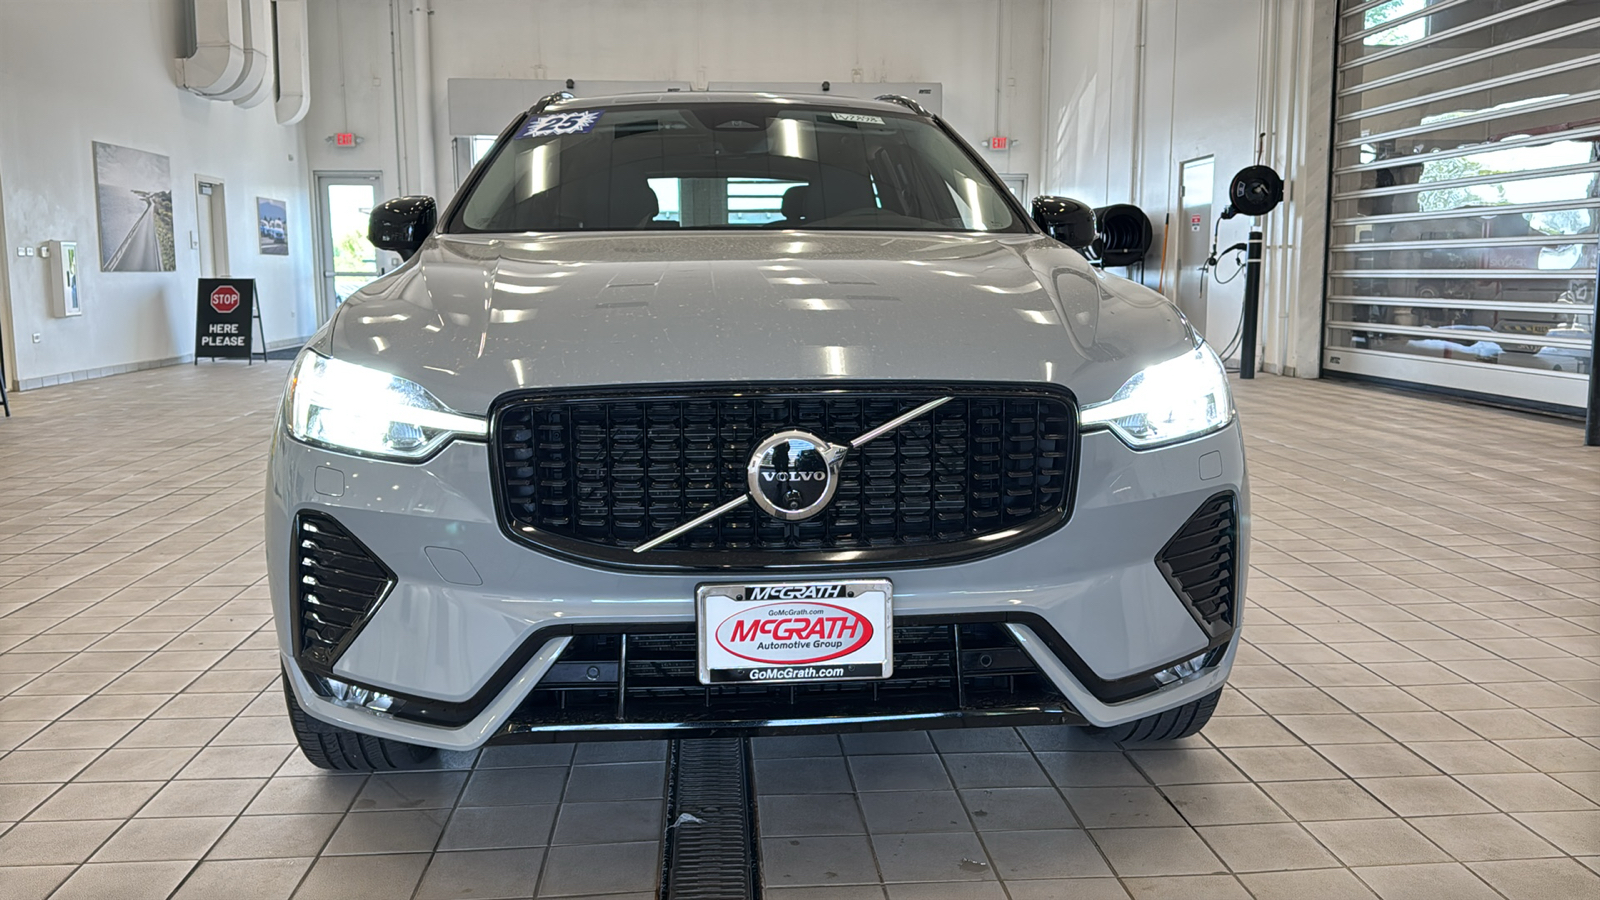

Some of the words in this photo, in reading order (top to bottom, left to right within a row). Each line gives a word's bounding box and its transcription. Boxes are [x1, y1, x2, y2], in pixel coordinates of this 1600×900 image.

[537, 115, 584, 132] 25
[337, 132, 352, 146] EXIT
[992, 137, 1007, 149] EXIT
[212, 294, 238, 305] STOP
[209, 323, 239, 334] HERE
[201, 336, 245, 347] PLEASE
[761, 471, 826, 482] VOLVO
[768, 608, 824, 617] GoMcGrath.com
[757, 641, 811, 651] Automotive
[812, 639, 843, 650] Group
[749, 667, 844, 680] GoMcGrath.com
